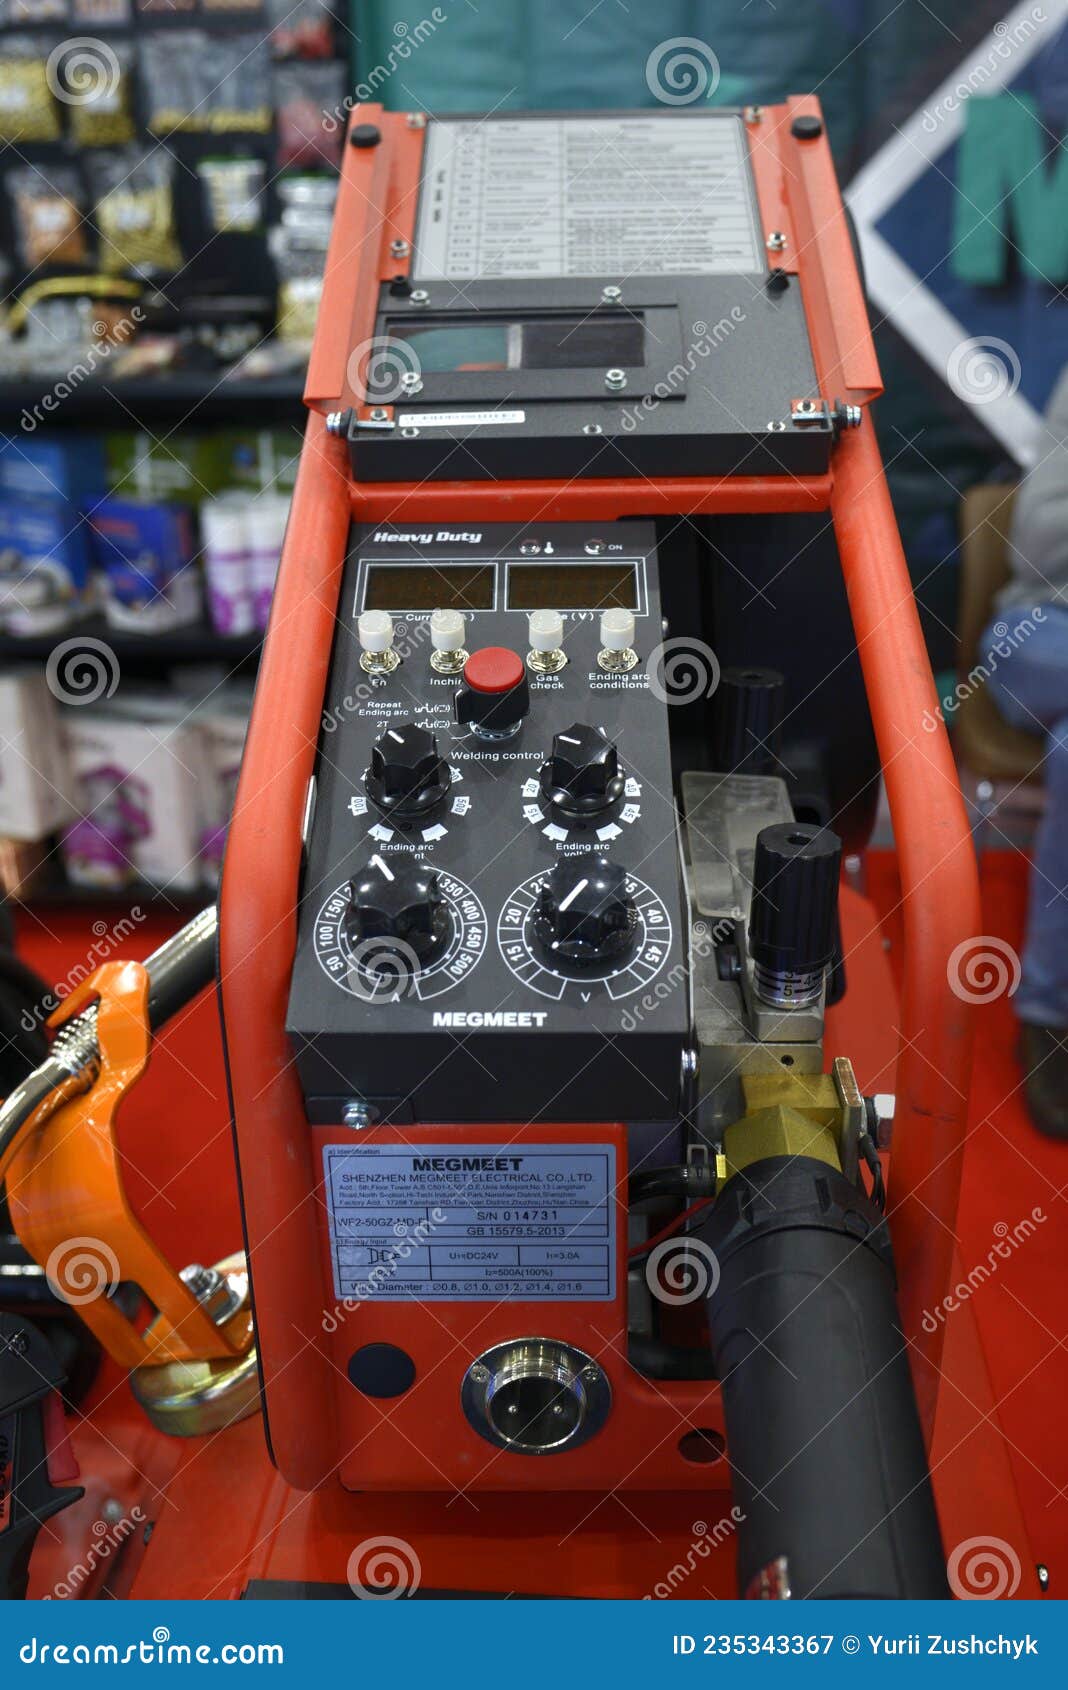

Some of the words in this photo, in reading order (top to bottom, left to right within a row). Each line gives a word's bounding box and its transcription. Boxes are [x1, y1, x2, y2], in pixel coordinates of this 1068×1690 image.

[373, 531, 433, 544] Heavy
[436, 531, 482, 544] Duty
[535, 674, 560, 682] Gas
[588, 672, 629, 682] Ending
[631, 673, 651, 681] arc
[530, 681, 565, 690] check
[589, 681, 650, 689] conditions
[367, 701, 402, 709] Repeat
[358, 709, 392, 717] Ending
[451, 751, 500, 761] Welding
[502, 751, 544, 760] control
[379, 843, 415, 852] Ending
[555, 842, 592, 851] Ending
[439, 878, 464, 898] 350
[324, 899, 345, 919] 150
[461, 899, 480, 921] 400
[505, 908, 522, 924] 20
[646, 909, 664, 924] 40
[319, 925, 334, 947] 100
[466, 926, 482, 948] 450
[506, 945, 525, 961] 15
[644, 945, 663, 963] 45
[326, 955, 344, 972] 50
[450, 952, 473, 975] 500
[580, 992, 591, 1002] V
[783, 984, 793, 997] 5
[432, 1011, 548, 1027] MEGMEET
[412, 1158, 524, 1172] MEGMEET
[341, 1173, 407, 1183] SHENZHEN
[409, 1173, 468, 1182] MEGMEET
[471, 1173, 543, 1182] ELECTRICAL
[477, 1211, 498, 1221] S/N
[503, 1210, 558, 1221] 014731
[466, 1226, 485, 1236] GB
[489, 1226, 565, 1236] 15579.5-2013
